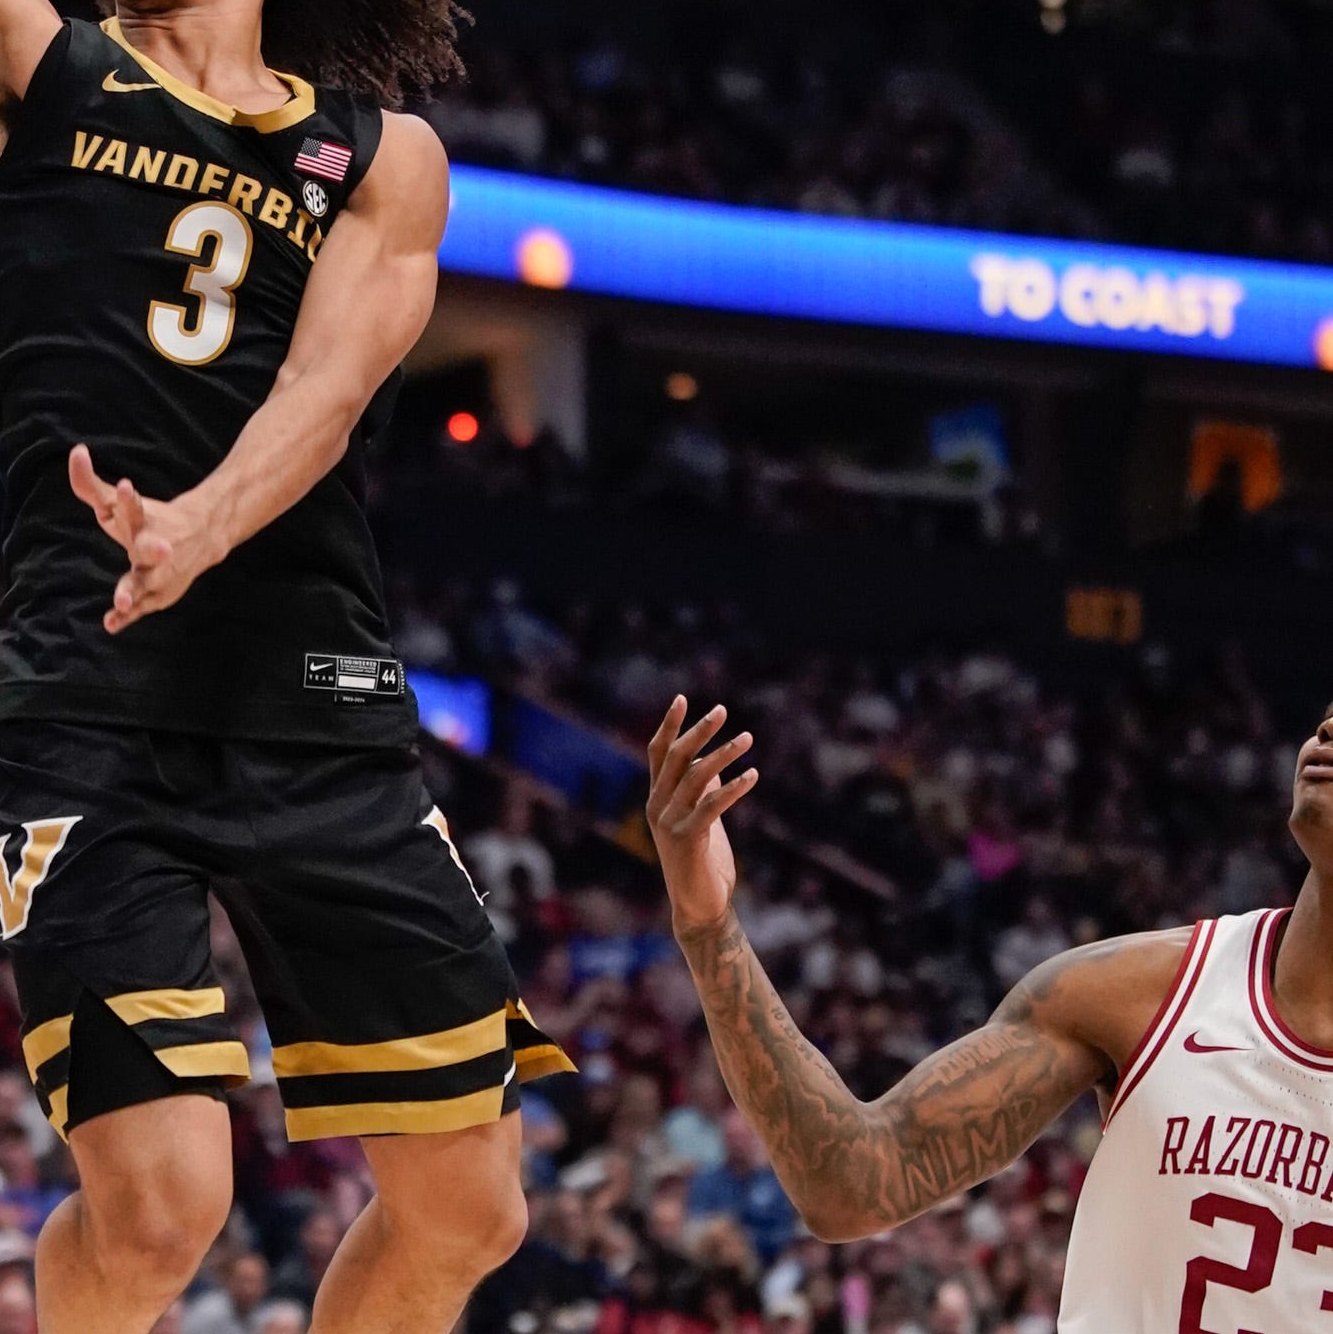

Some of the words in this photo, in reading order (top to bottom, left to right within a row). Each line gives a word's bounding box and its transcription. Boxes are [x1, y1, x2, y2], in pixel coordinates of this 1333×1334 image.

[147, 200, 254, 366] 3
[969, 251, 1057, 323] TO
[1058, 262, 1245, 340] COAST
[309, 673, 334, 682] TEAM
[381, 669, 396, 684] 44
[1158, 1115, 1333, 1202] RAZORB
